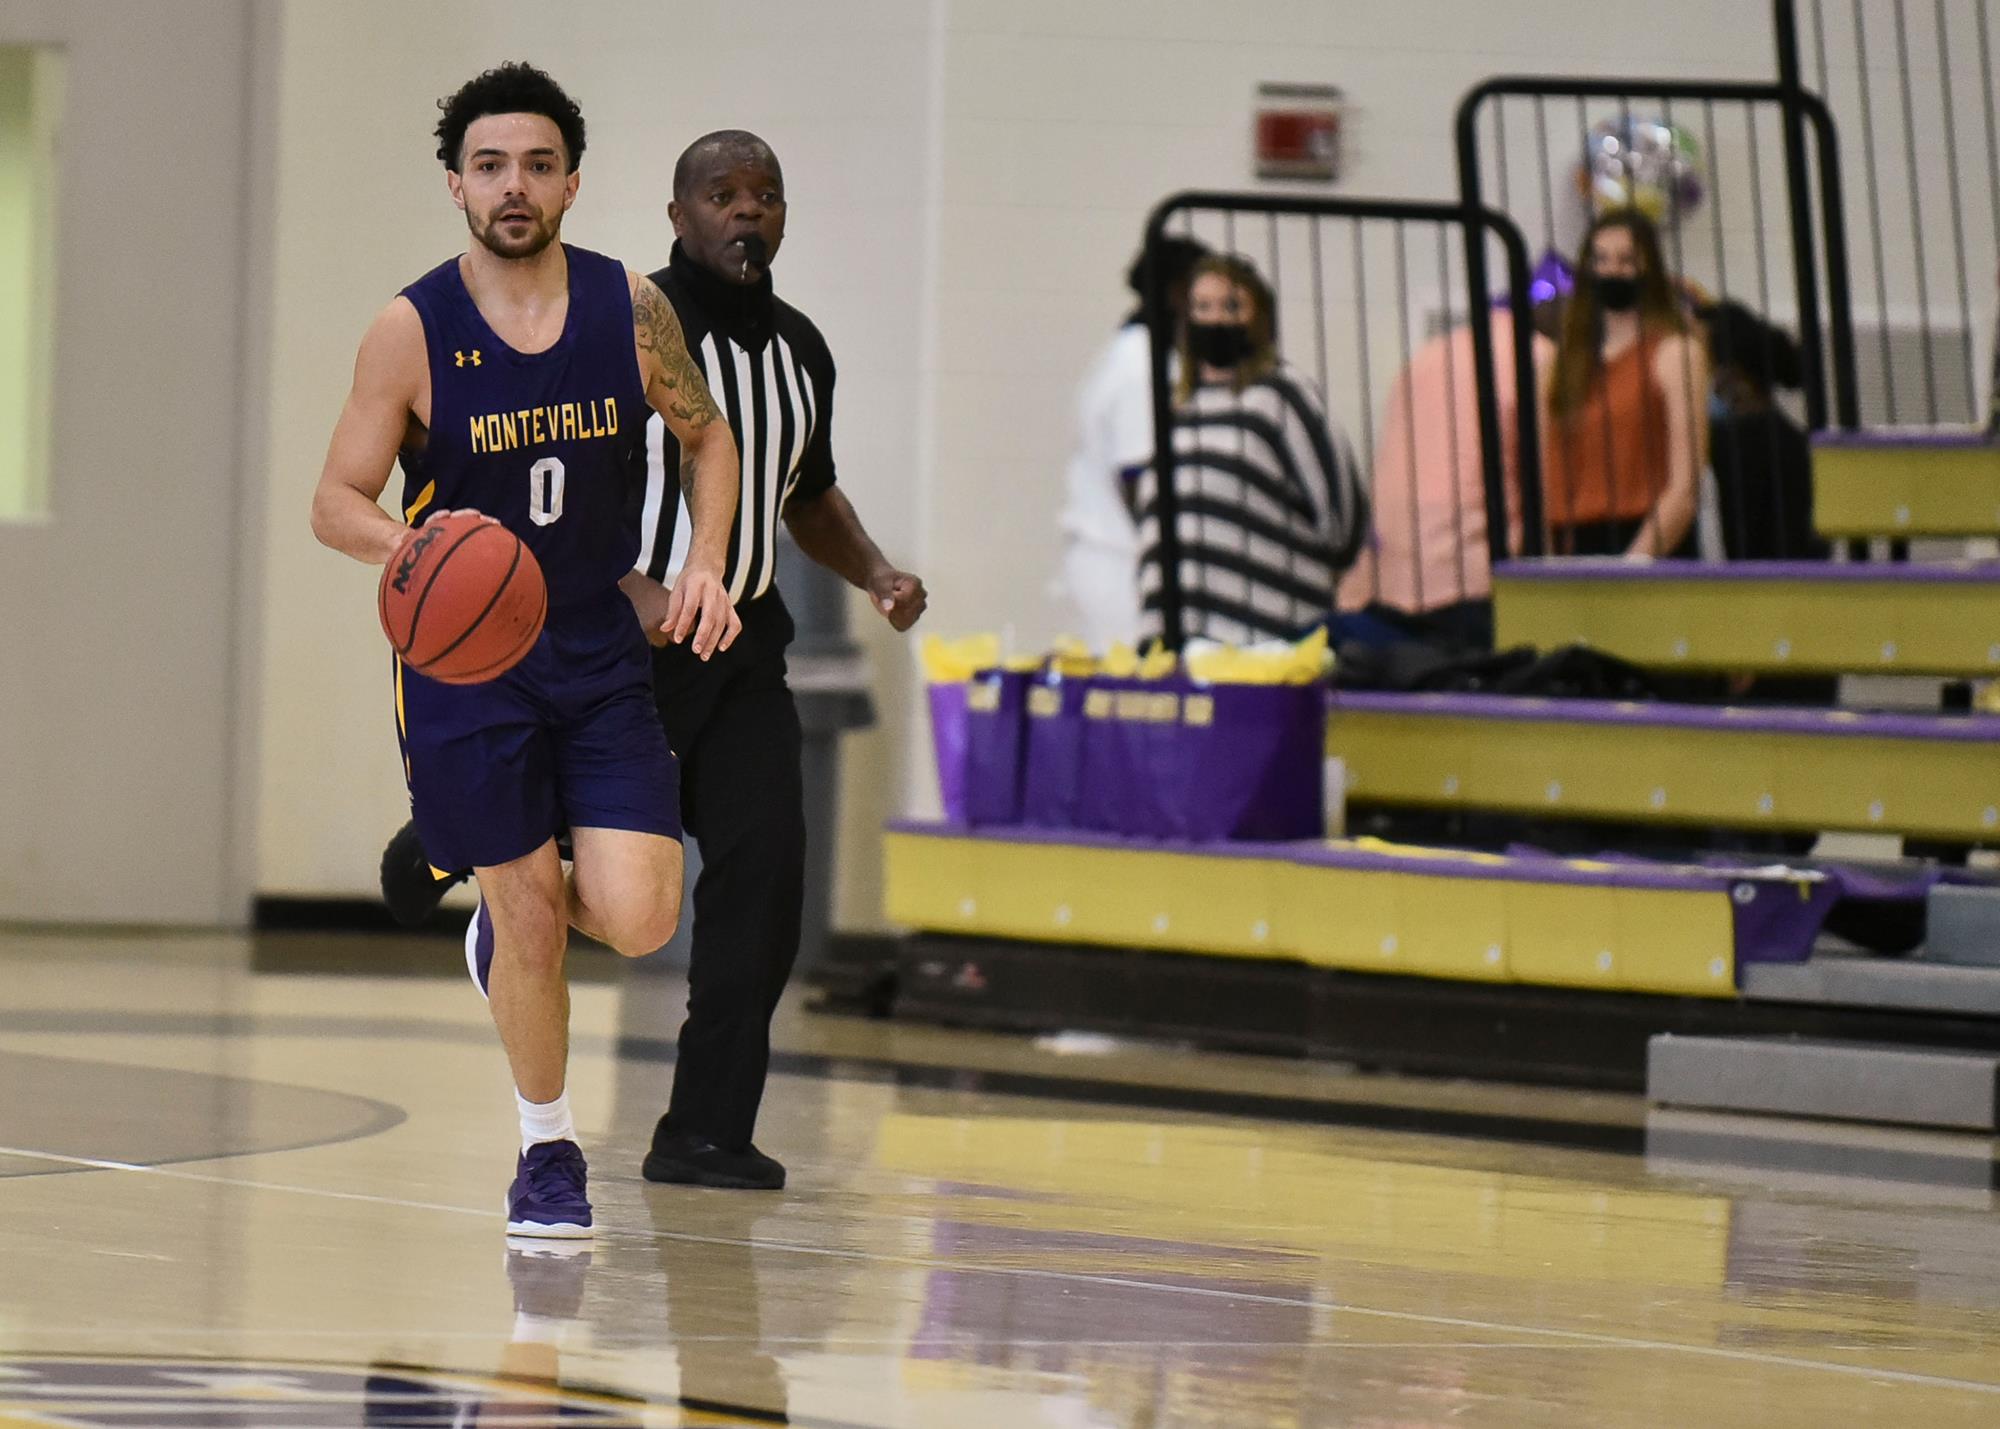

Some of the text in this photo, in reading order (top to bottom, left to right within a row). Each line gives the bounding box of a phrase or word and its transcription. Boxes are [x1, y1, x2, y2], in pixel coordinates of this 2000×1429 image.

[470, 397, 618, 453] MONTEVALLO
[529, 456, 565, 526] 0
[391, 526, 445, 595] NCAA
